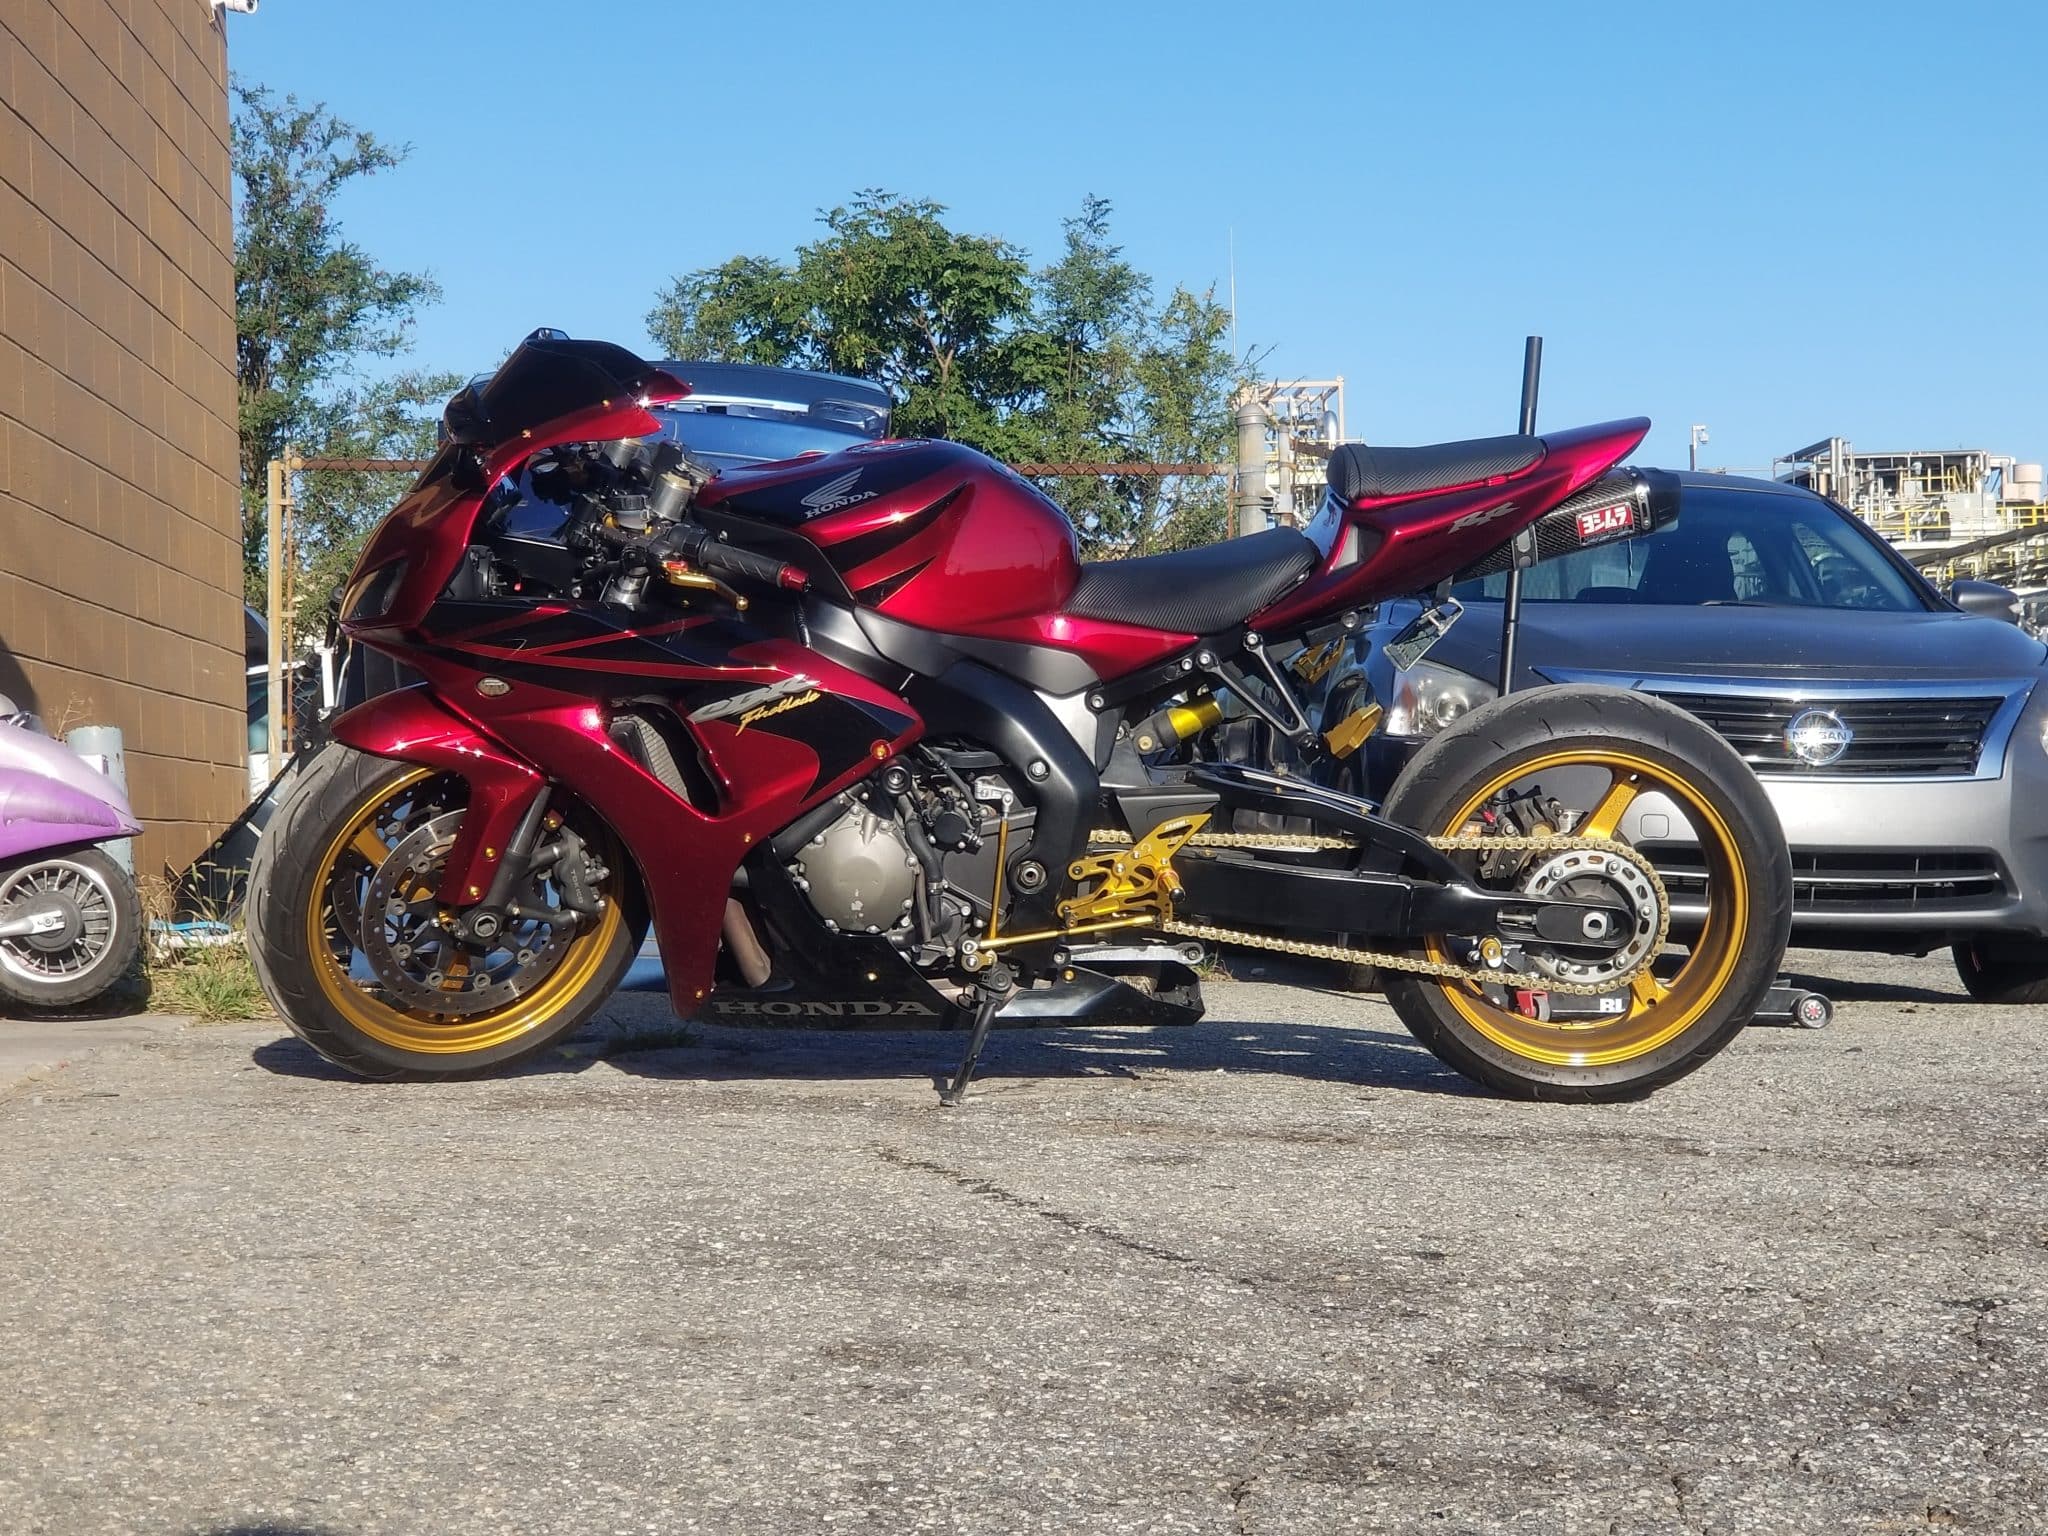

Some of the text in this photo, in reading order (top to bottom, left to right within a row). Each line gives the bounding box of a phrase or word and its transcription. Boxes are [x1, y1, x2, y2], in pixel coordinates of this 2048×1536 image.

[804, 491, 879, 519] HONDA
[1582, 506, 1628, 535] ヨシムラ
[686, 674, 821, 724] CBR
[735, 690, 820, 736] Fireblade
[1792, 730, 1847, 741] NSAN
[712, 1001, 939, 1016] HONDA
